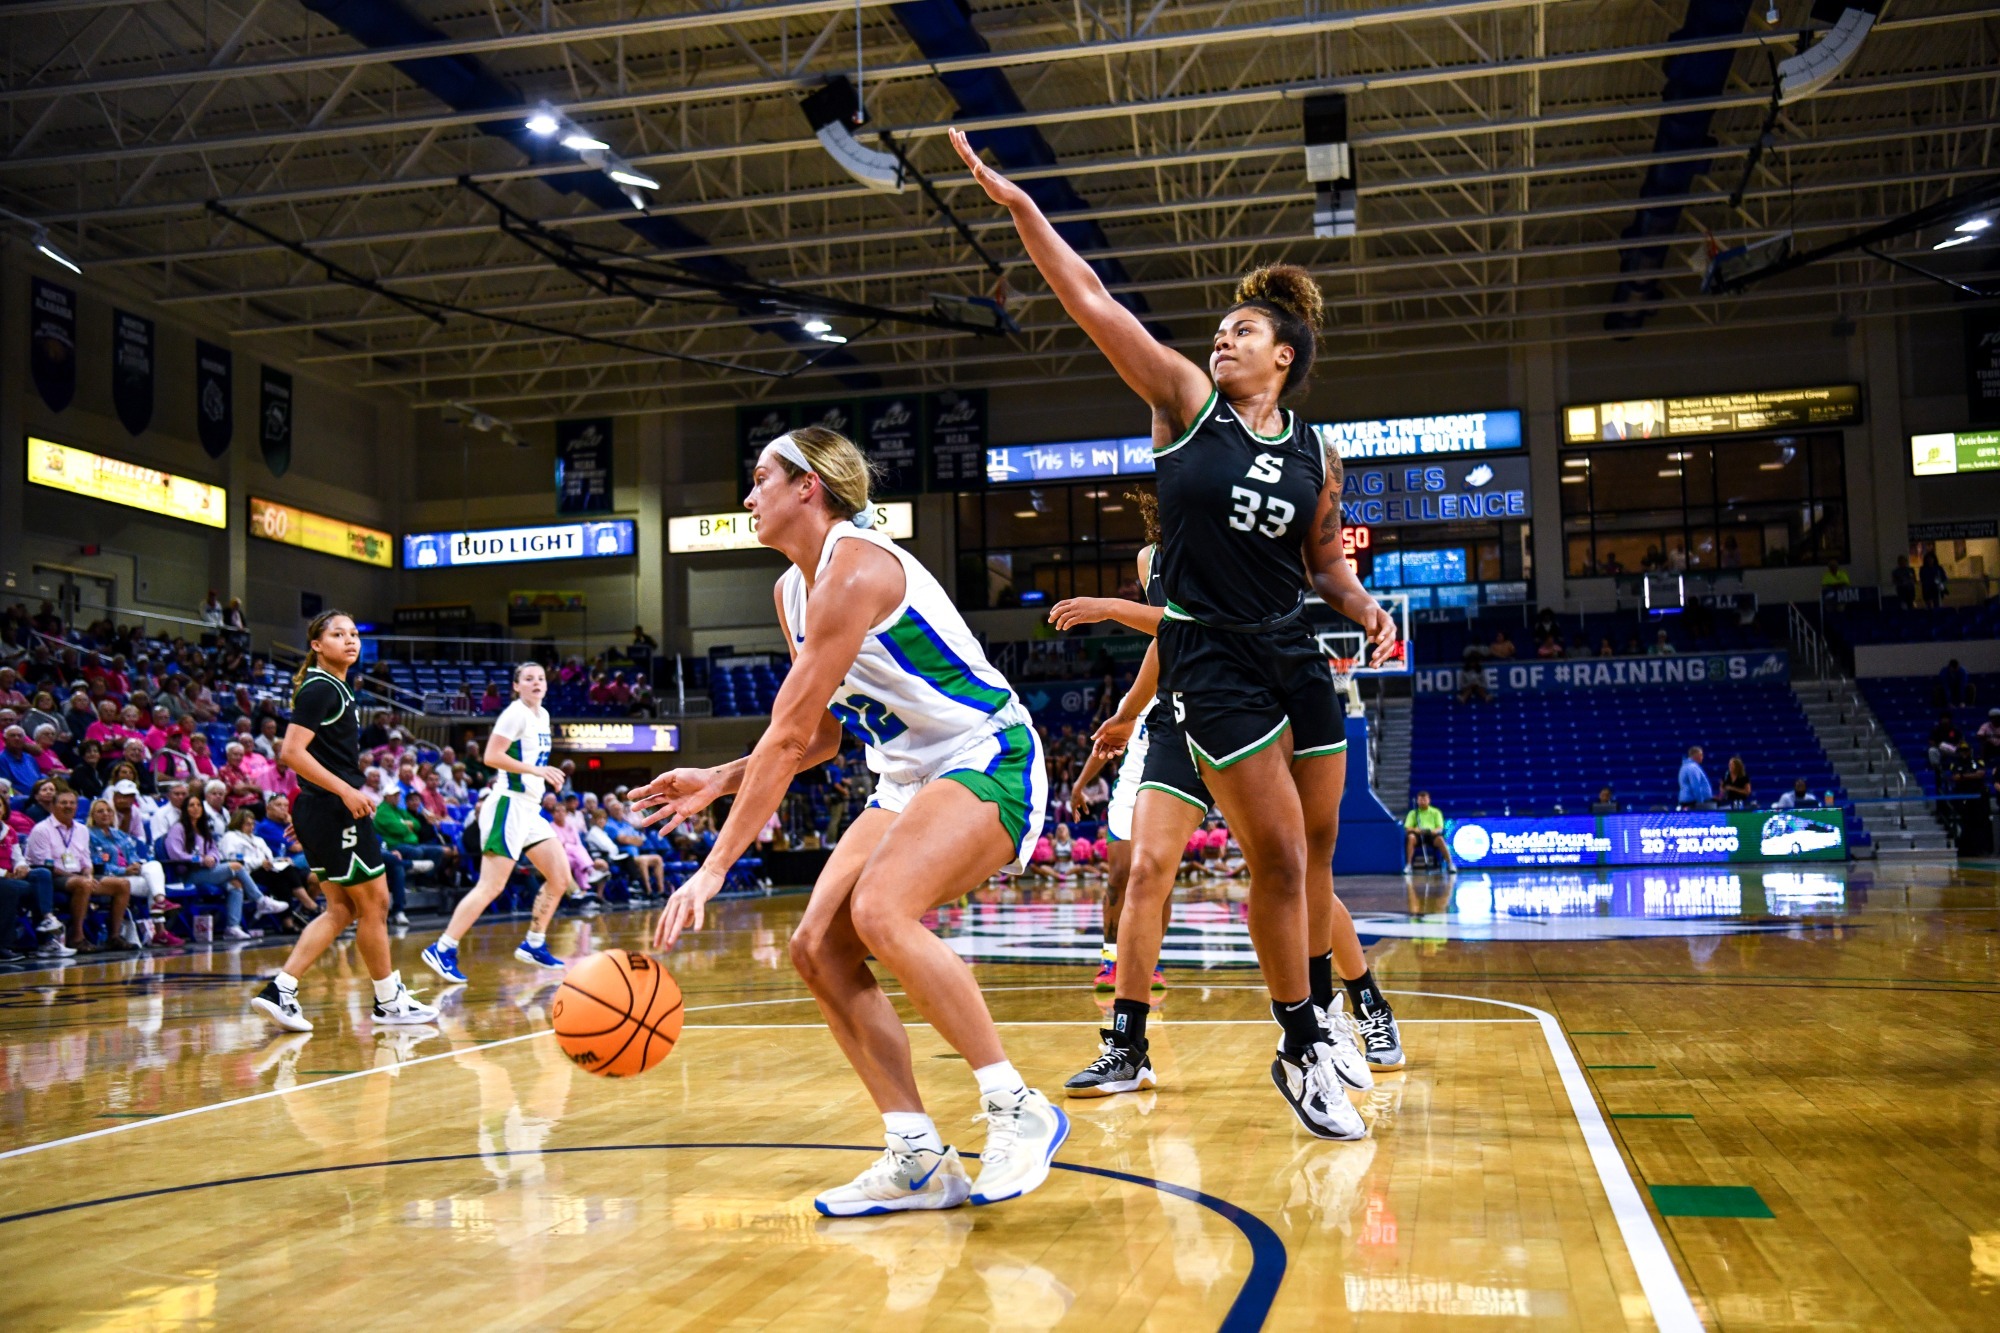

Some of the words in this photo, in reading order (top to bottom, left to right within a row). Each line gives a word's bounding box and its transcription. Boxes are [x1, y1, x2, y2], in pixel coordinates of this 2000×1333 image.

[1758, 391, 1804, 404] Management
[1805, 389, 1829, 401] Group
[1420, 430, 1487, 452] SUITE
[1022, 448, 1065, 471] This
[1070, 446, 1086, 469] is
[1092, 448, 1118, 475] my
[1244, 453, 1284, 484] S
[1342, 466, 1446, 495] AGLES
[1228, 485, 1296, 539] 33
[1341, 490, 1525, 525] XCELLENCE
[264, 507, 288, 538] 60
[458, 538, 504, 556] BUD
[510, 533, 575, 552] LIGHT
[1416, 667, 1500, 692] HOE
[1509, 666, 1544, 689] OF
[341, 825, 358, 850] S
[1710, 824, 1737, 836] from
[1641, 838, 1665, 854] 20
[1676, 837, 1739, 854] 20,000
